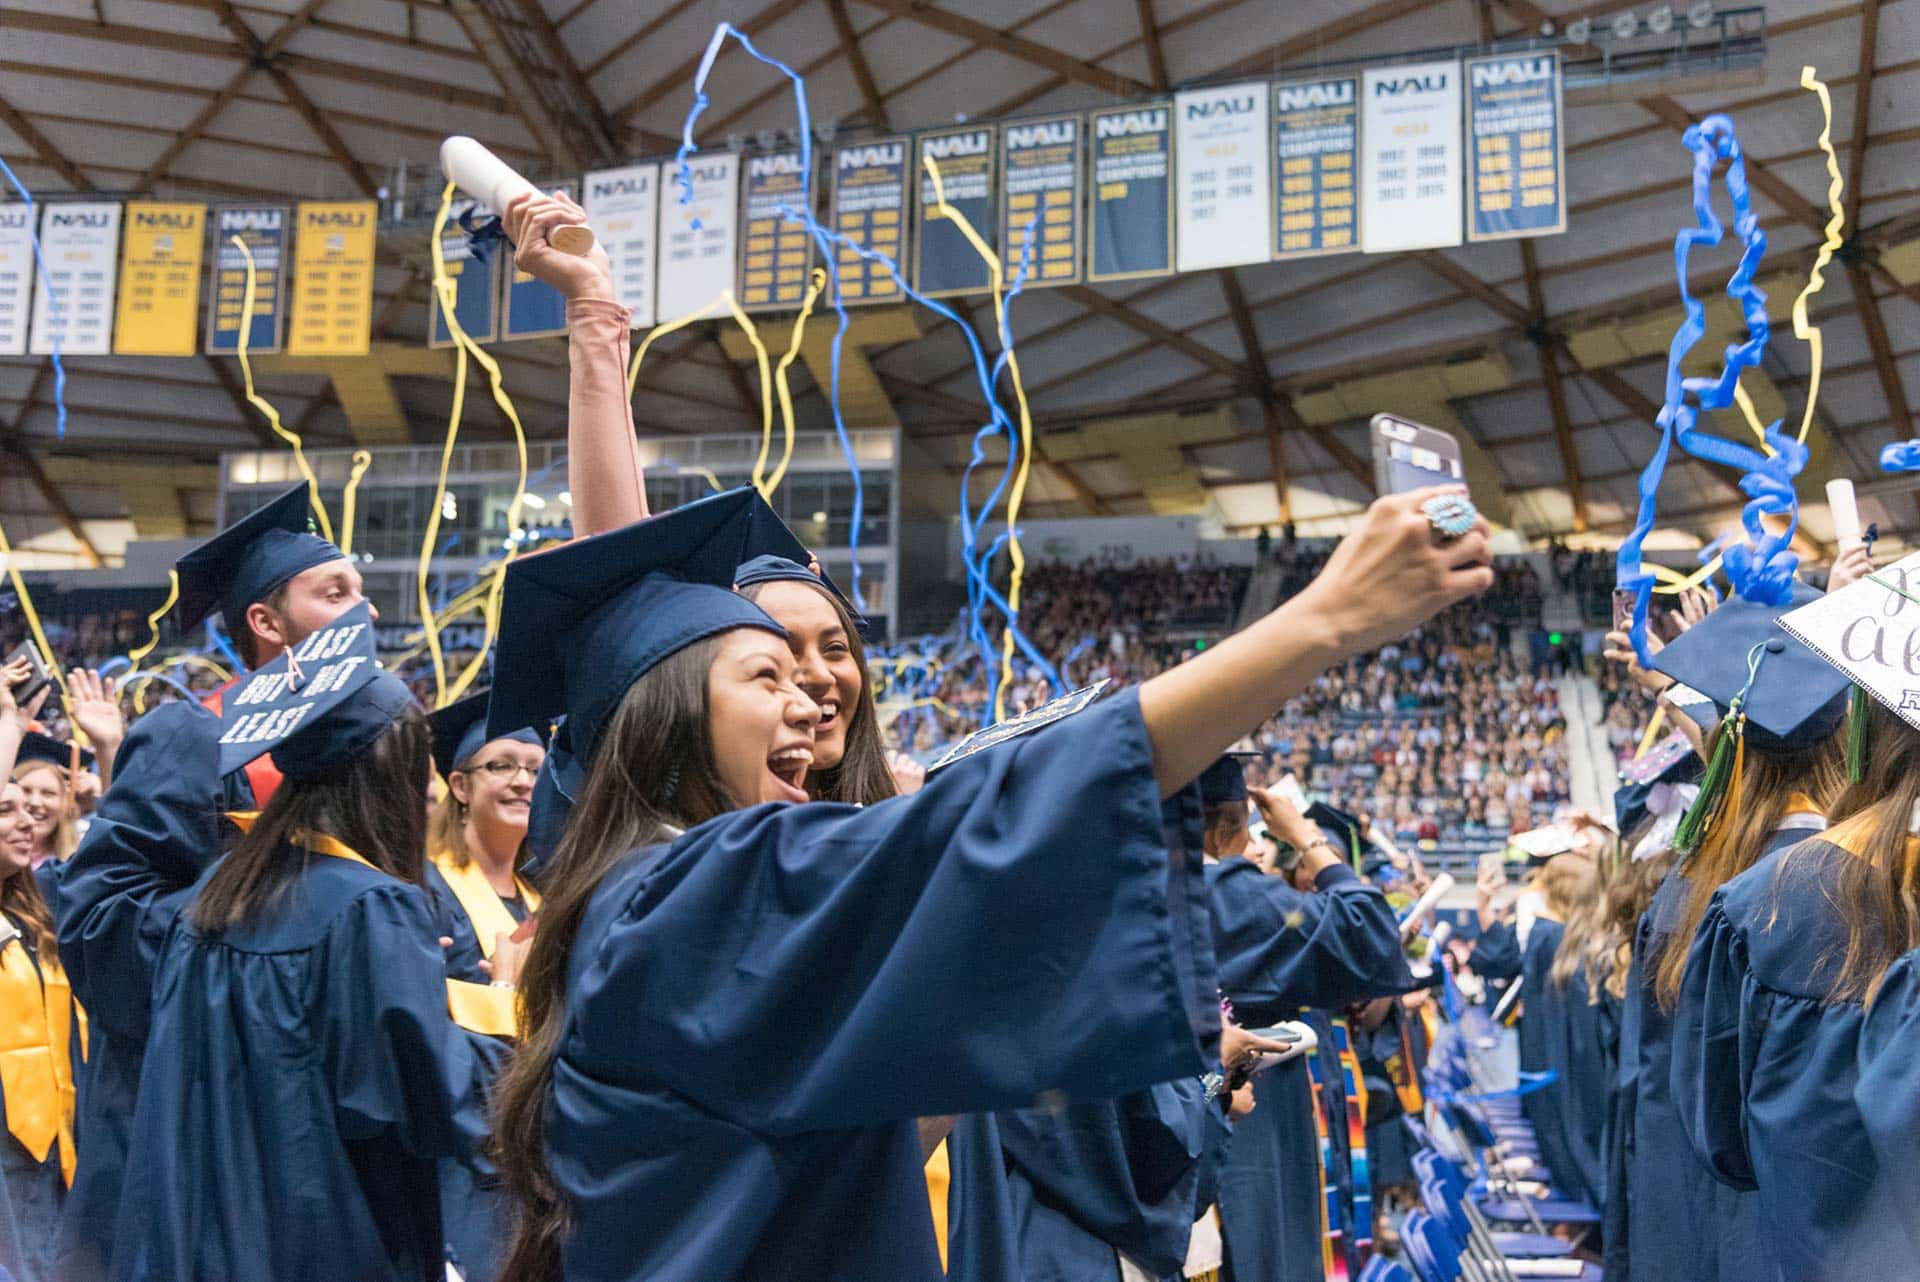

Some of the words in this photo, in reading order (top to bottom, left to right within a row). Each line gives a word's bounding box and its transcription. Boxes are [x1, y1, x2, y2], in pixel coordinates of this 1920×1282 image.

[1375, 74, 1447, 97] NAU
[1473, 58, 1552, 88] NAU
[1187, 96, 1255, 120] NAU
[1278, 82, 1353, 112] NAU
[1007, 121, 1075, 149] NAU
[1096, 110, 1168, 138] NAU
[839, 143, 903, 169] NAU
[923, 132, 988, 158] NAU
[593, 177, 648, 199] NAU
[52, 213, 110, 228] NAU
[136, 212, 196, 229] NAU
[221, 210, 283, 231] NAU
[307, 212, 367, 228] NAU
[294, 623, 367, 662] LAST
[233, 671, 299, 706] BUT
[218, 702, 316, 744] LEAST
